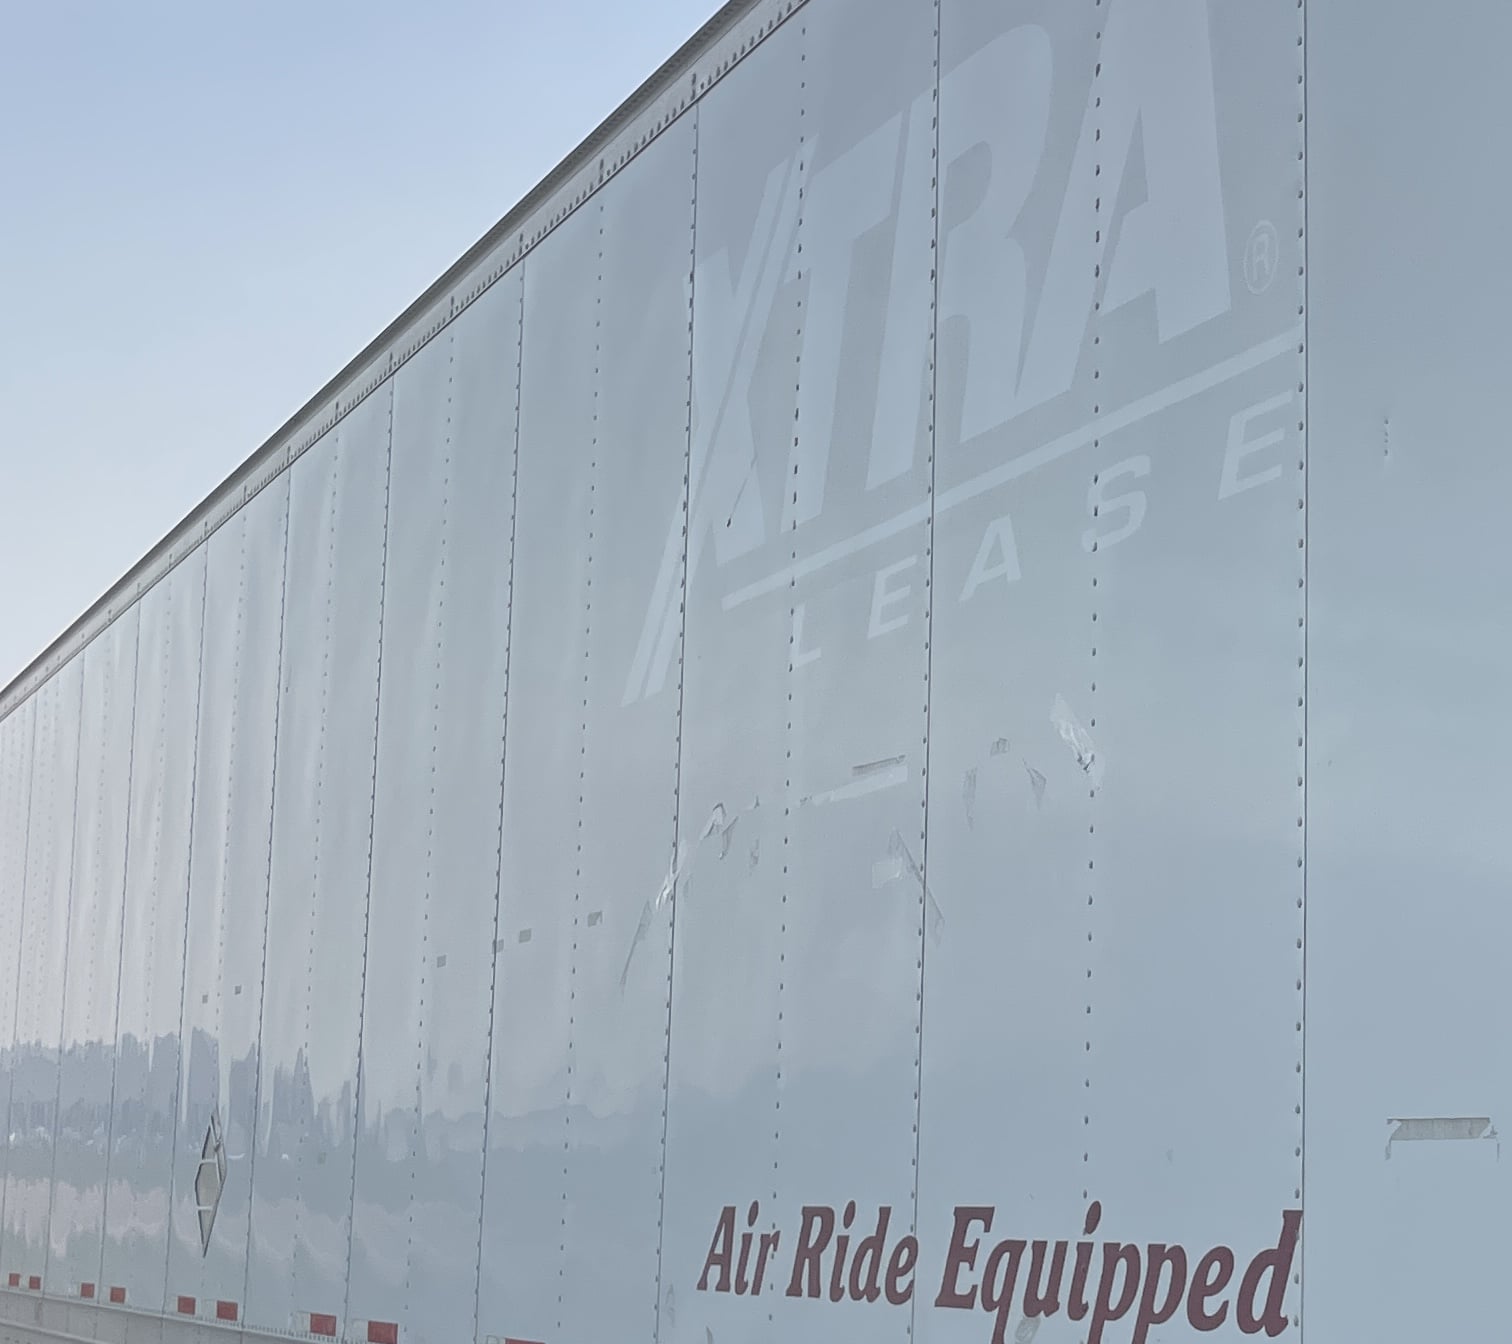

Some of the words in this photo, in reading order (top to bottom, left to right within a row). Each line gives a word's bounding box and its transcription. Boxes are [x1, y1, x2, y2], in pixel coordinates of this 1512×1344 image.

[787, 388, 1294, 672] LEASE
[696, 1200, 780, 1296] Air
[785, 1200, 920, 1305] Ride
